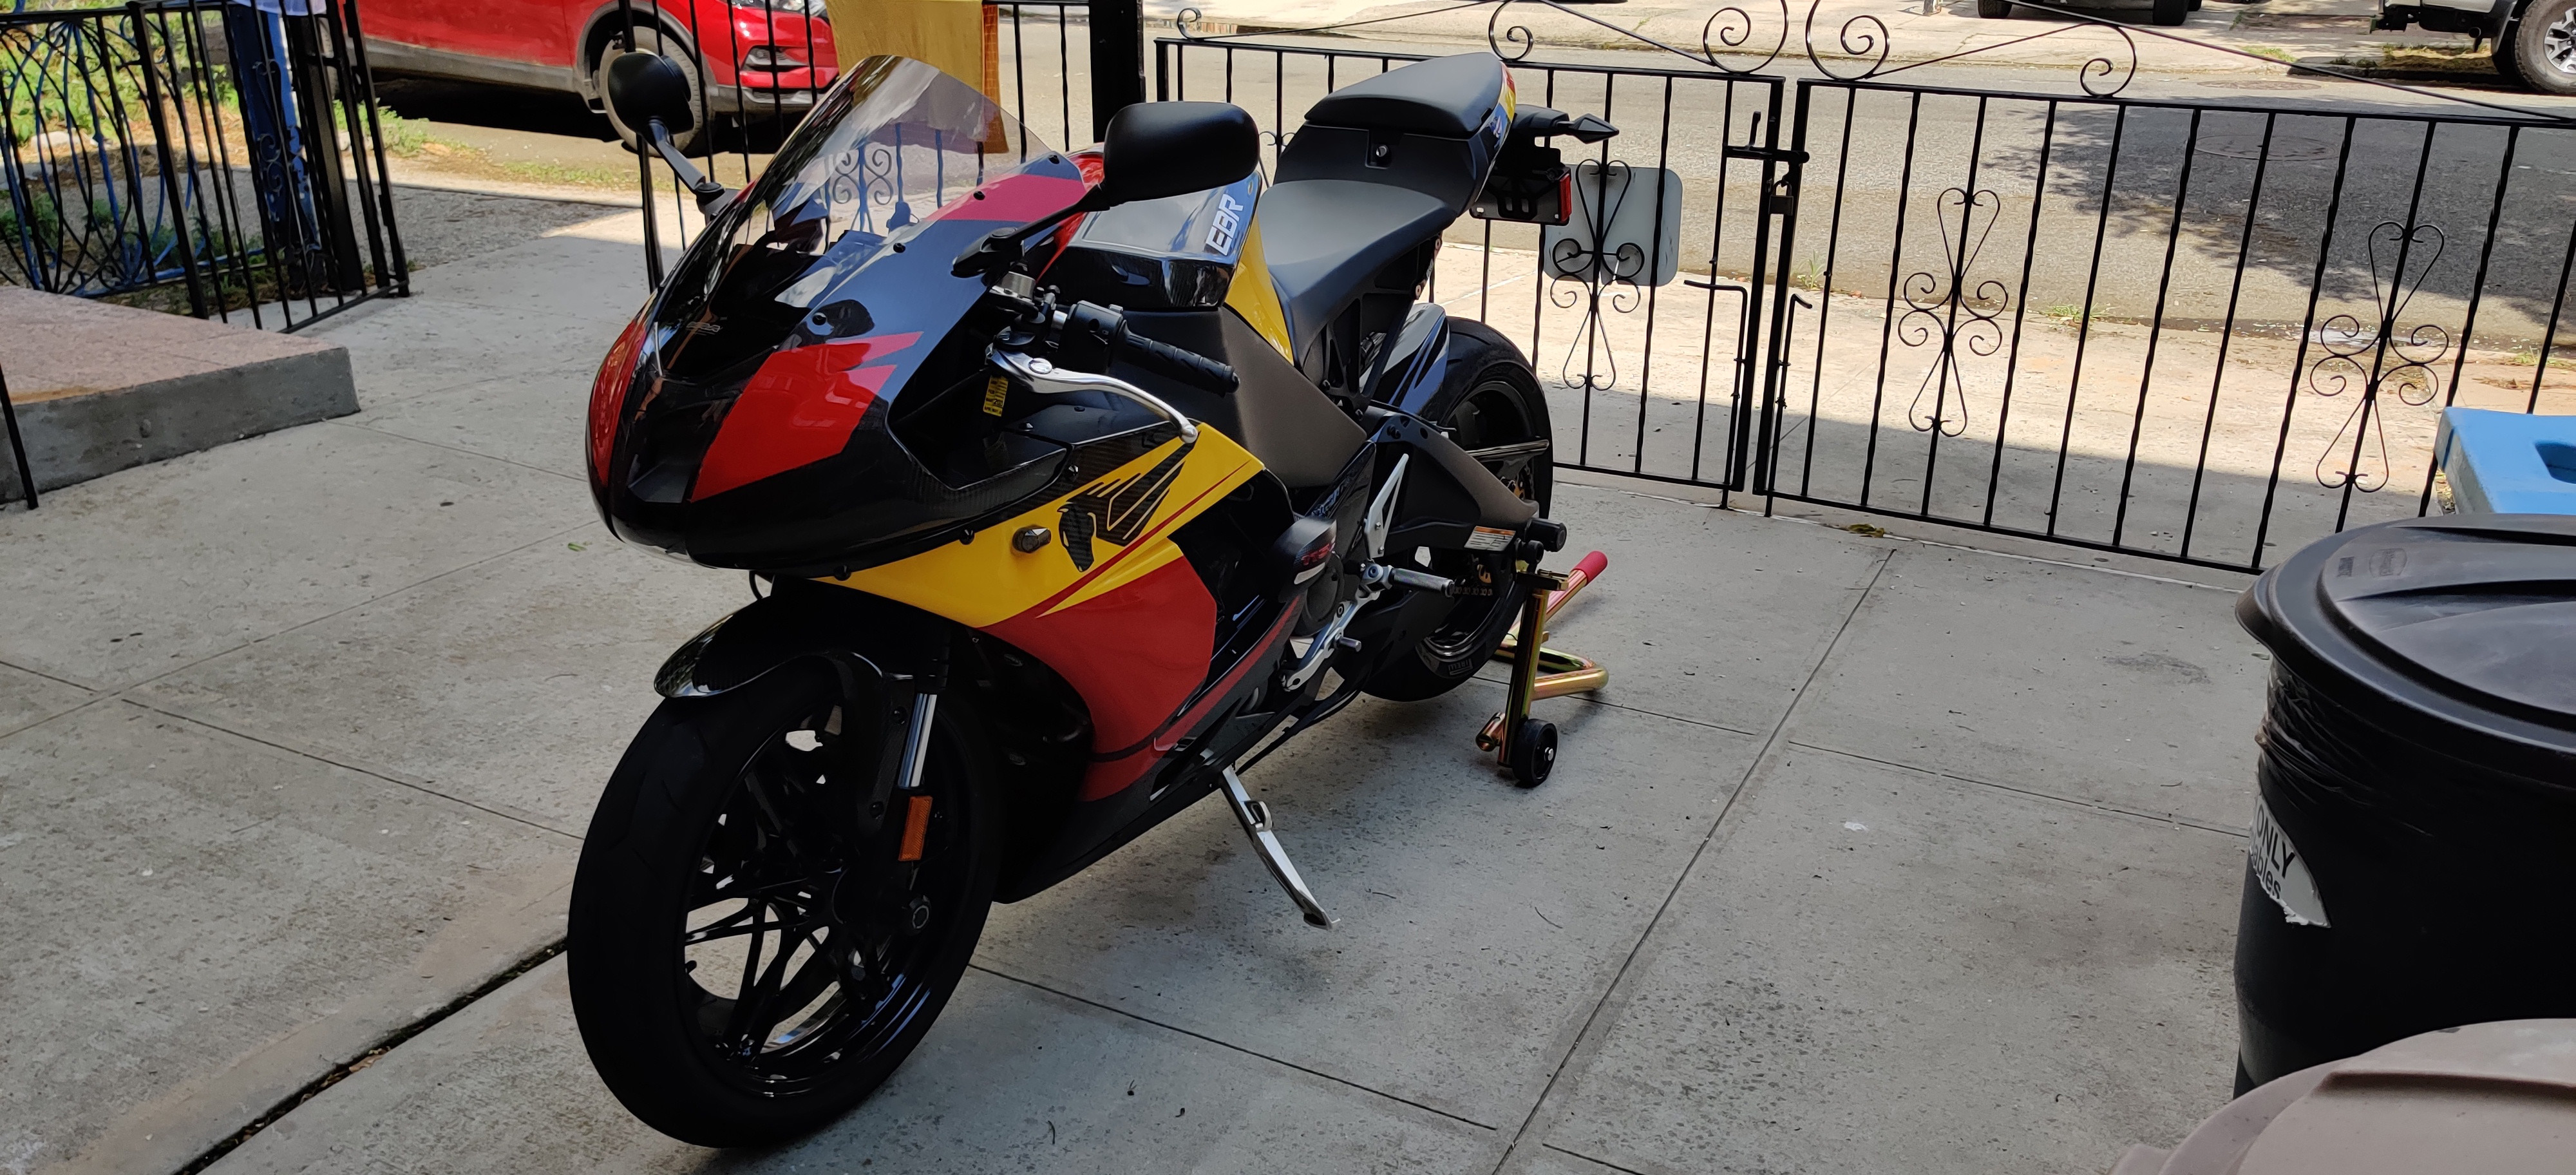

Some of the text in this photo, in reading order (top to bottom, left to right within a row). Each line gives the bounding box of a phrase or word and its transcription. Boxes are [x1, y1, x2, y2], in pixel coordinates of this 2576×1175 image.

[1206, 193, 1244, 256] EBR
[1448, 658, 1473, 676] PIRELLI
[2257, 804, 2295, 879] ONLY
